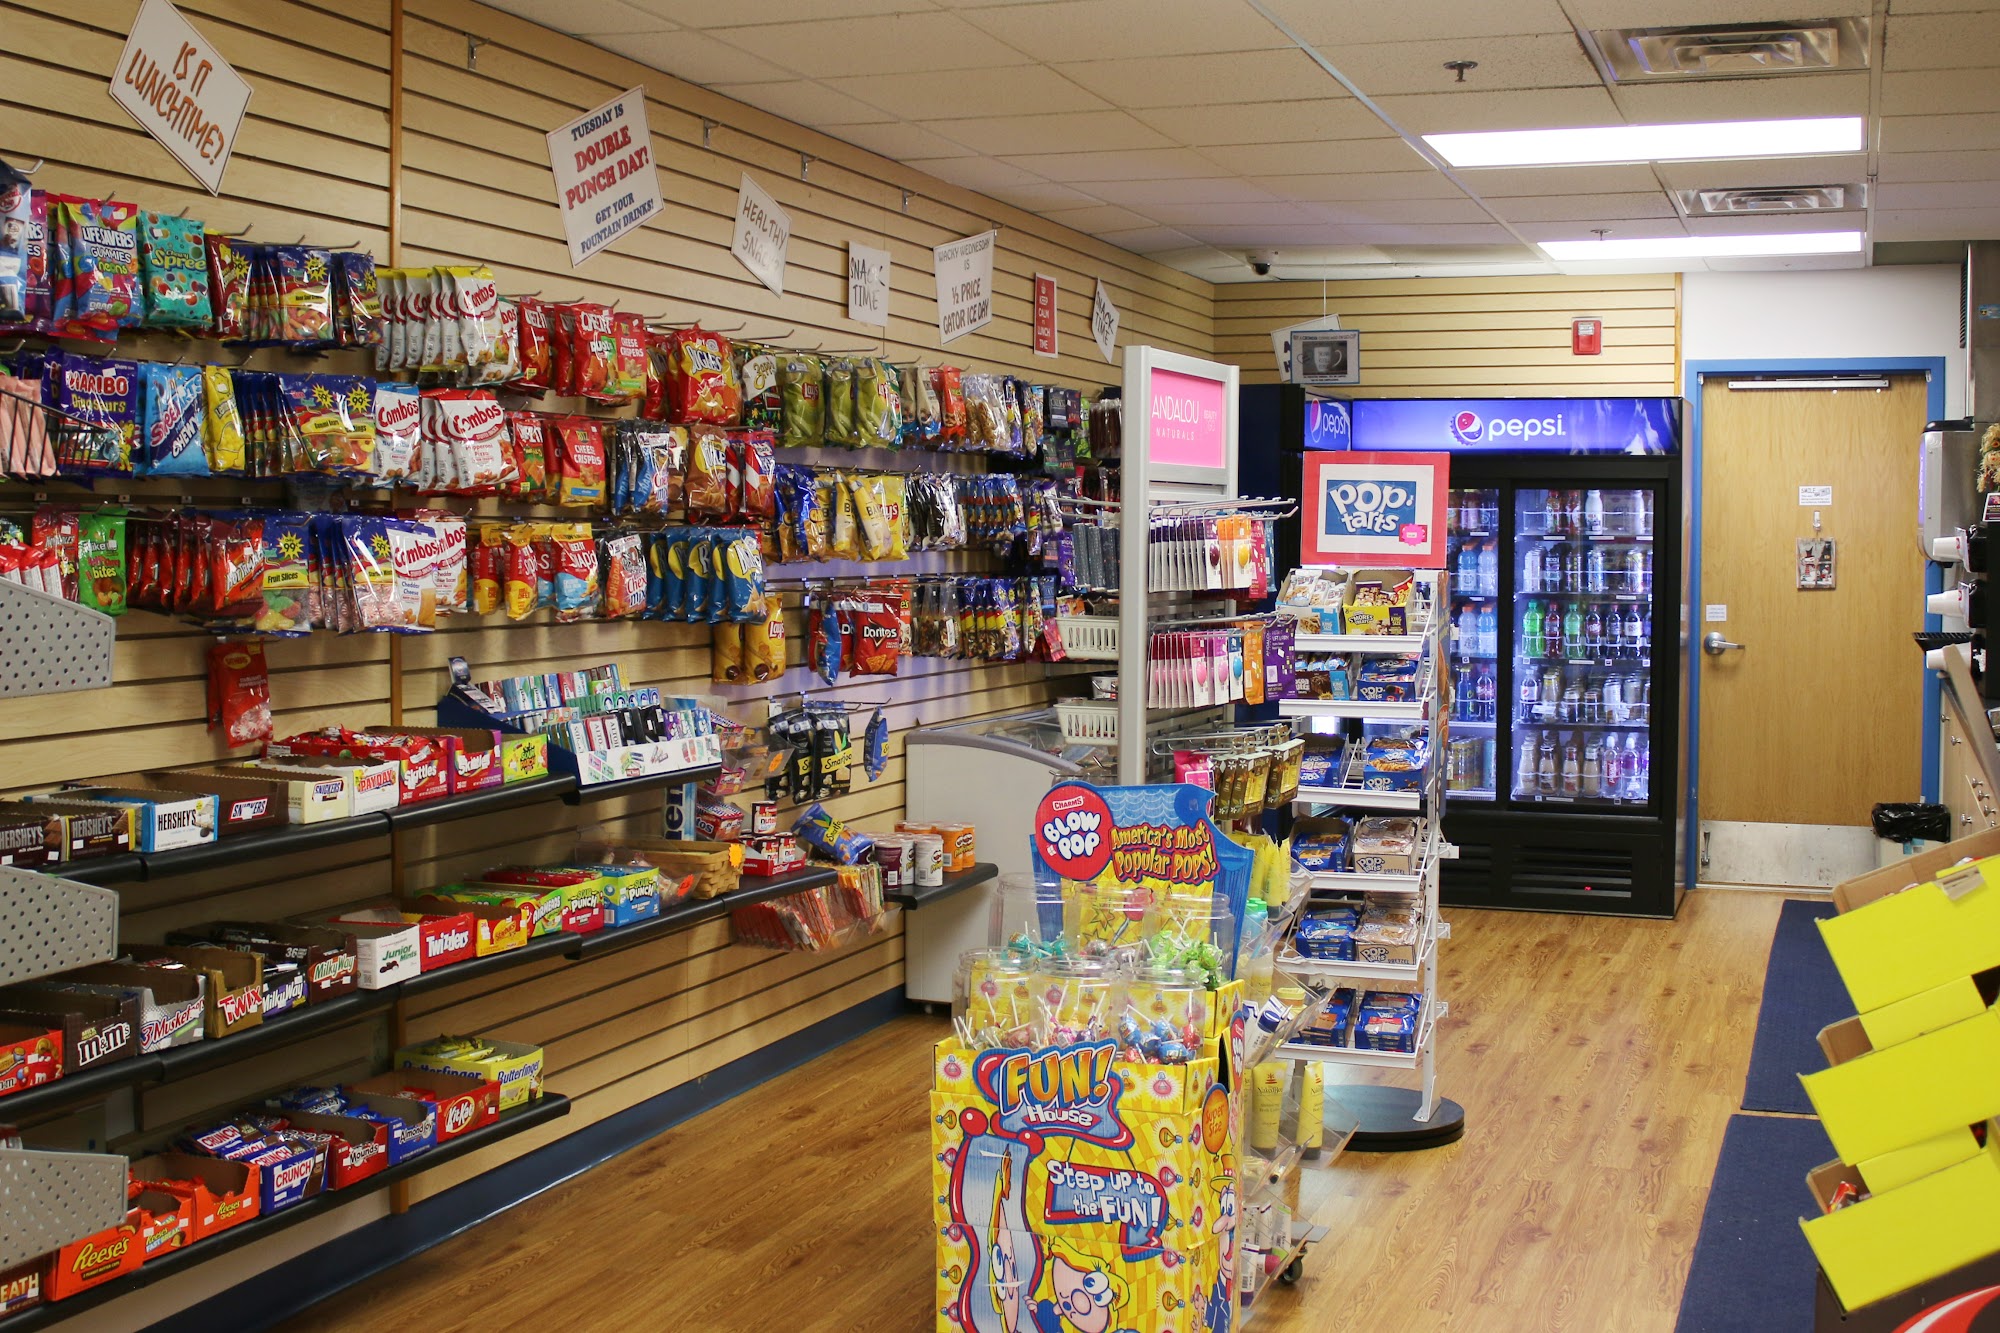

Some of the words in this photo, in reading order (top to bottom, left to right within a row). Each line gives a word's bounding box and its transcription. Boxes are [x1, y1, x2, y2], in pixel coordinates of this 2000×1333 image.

[173, 41, 197, 81] IS
[125, 48, 225, 166] LUNCHTIME?
[571, 108, 613, 142] TUESDAY
[613, 103, 624, 118] IS
[574, 125, 632, 173] DOUBLE
[565, 165, 617, 211] PUNCH
[616, 145, 650, 181] DAY!
[595, 206, 612, 225] GET
[612, 192, 635, 214] YOUR
[580, 218, 623, 254] FOUNTAIN
[622, 198, 654, 228] DRINKS!
[742, 195, 787, 251] HEALTHY
[82, 226, 135, 249] LIFESAVERS
[938, 246, 960, 263] WACKY
[959, 237, 991, 257] WEDNESDAY
[90, 246, 132, 264] GUMMIES
[151, 249, 207, 272] Spree
[963, 259, 970, 271] IS
[98, 261, 128, 275] neons
[853, 285, 880, 312] TIME
[960, 278, 981, 302] PRICE
[942, 309, 966, 336] GATOR
[966, 306, 977, 326] ICE
[977, 299, 990, 322] DAY
[66, 370, 129, 396] HARIBO
[72, 393, 126, 413] Dinosaurs
[378, 399, 419, 428] Combos
[1151, 393, 1200, 424] ANDALOU
[453, 403, 502, 434] Combos
[1322, 411, 1347, 437] pepsi
[1488, 413, 1563, 442] pepsi
[1156, 427, 1195, 441] NATURALS
[1341, 508, 1400, 534] tarts
[92, 565, 117, 578] bites
[267, 575, 281, 584] Fruit
[281, 572, 299, 581] Slices
[627, 574, 647, 594] Chex
[401, 581, 420, 589] Cheddar
[403, 588, 419, 596] Cheese
[863, 626, 897, 639] Doritos
[315, 781, 341, 793] SNICKERS
[360, 770, 393, 793] PAYDAY
[404, 764, 437, 790] Skittles
[1054, 797, 1083, 810] CHARMS
[72, 815, 113, 839] HERSHEY'S
[157, 808, 197, 832] HERSHEY'S
[1043, 811, 1101, 843] BLOW
[1058, 833, 1100, 860] POP
[1111, 826, 1172, 850] America's
[1175, 823, 1210, 850] Most
[1115, 848, 1171, 877] Popular
[1172, 844, 1217, 881] POPS!
[629, 883, 654, 901] PUNCH
[634, 878, 649, 888] SOUR
[533, 896, 561, 924] AIRHEADS
[571, 894, 597, 912] PUNCH
[286, 948, 297, 958] 36
[382, 944, 413, 961] Junior
[400, 951, 417, 961] Mints
[426, 928, 469, 958] Twizzlers
[313, 960, 339, 983] Milky
[337, 954, 356, 973] Way
[285, 982, 304, 1003] Way
[218, 985, 263, 1026] Twix
[78, 1022, 131, 1066] m&m's
[141, 1023, 154, 1049] 3
[497, 1060, 541, 1084] Butterfinger
[1006, 1046, 1115, 1106] FUN!
[1028, 1104, 1093, 1127] House
[1204, 1103, 1224, 1124] Super
[201, 1125, 240, 1150] CRUNCH
[399, 1124, 422, 1144] Almond
[1208, 1120, 1223, 1135] Size
[254, 1147, 292, 1165] CRUNCH
[350, 1142, 379, 1163] Mounds
[275, 1161, 313, 1187] CRUNCH
[1046, 1159, 1105, 1200] Step
[1110, 1171, 1132, 1193] up
[1136, 1173, 1156, 1196] to
[216, 1200, 241, 1216] Reese's
[1073, 1197, 1098, 1216] the
[1099, 1196, 1162, 1228] FUN!
[72, 1237, 129, 1273] Reese's
[146, 1238, 163, 1253] FAST
[1, 1273, 39, 1303] EATH
